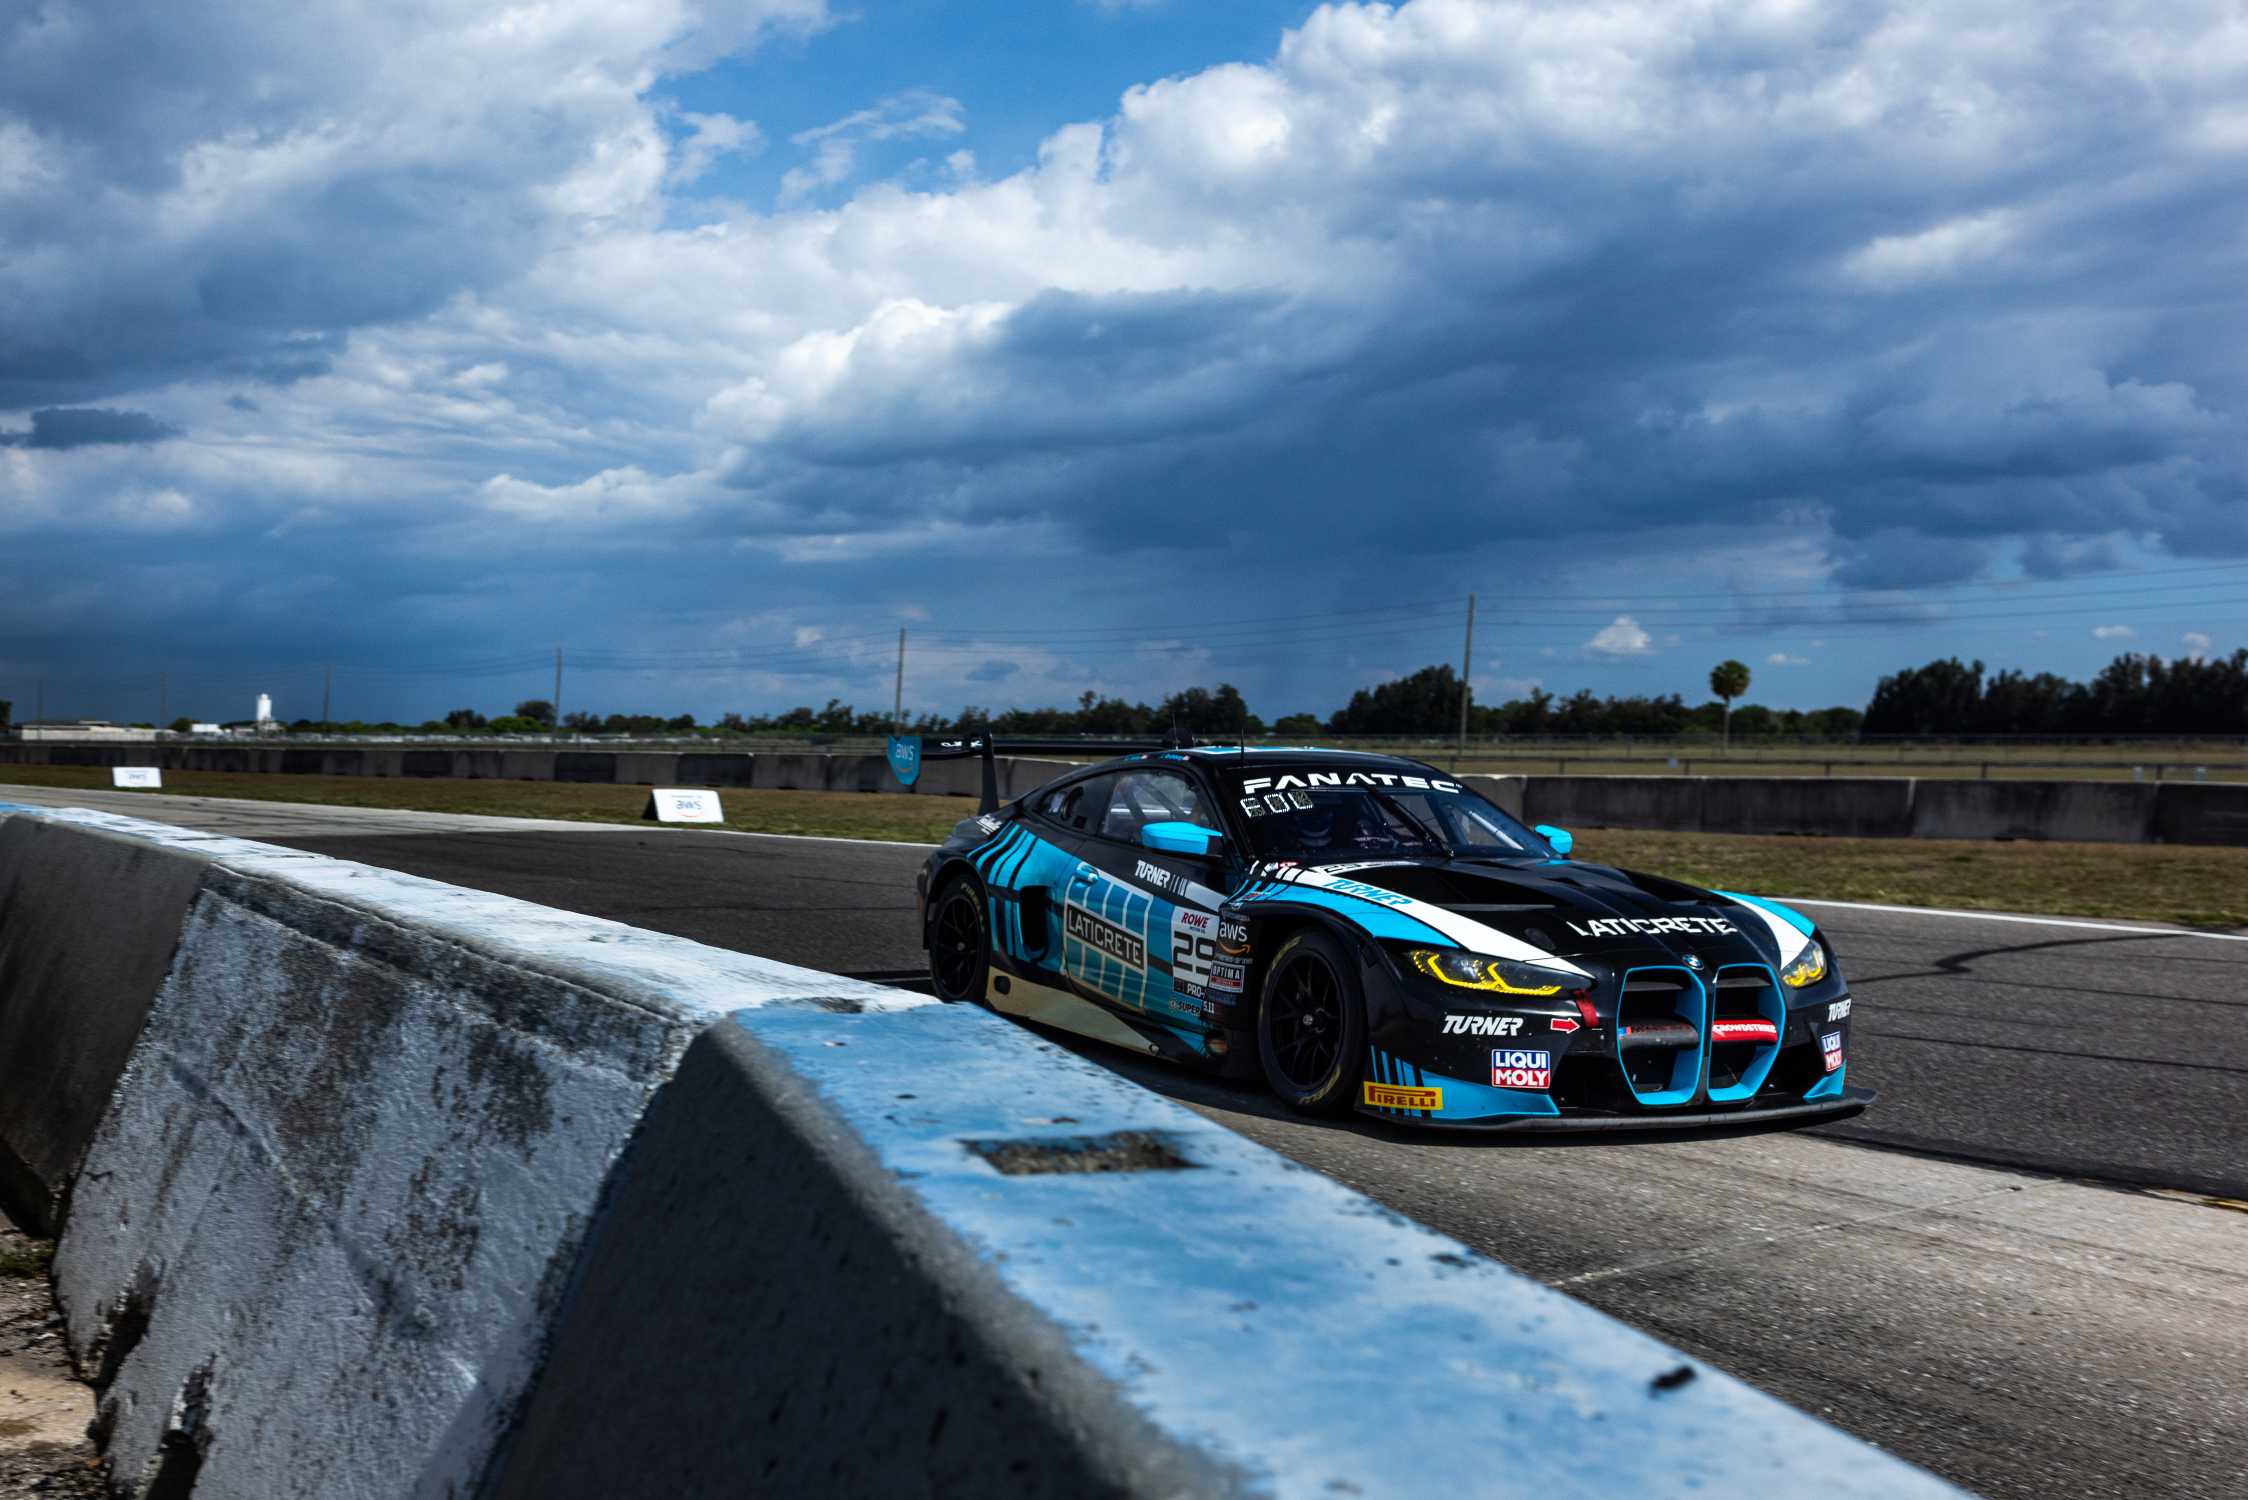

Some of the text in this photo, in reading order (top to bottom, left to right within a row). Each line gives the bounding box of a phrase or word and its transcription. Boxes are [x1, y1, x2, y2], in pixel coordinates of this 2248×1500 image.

[1243, 772, 1460, 794] FANATEC
[1135, 860, 1170, 889] TURNER
[1322, 879, 1413, 905] TURNER
[1181, 912, 1210, 928] ROWE
[1565, 917, 1738, 937] LATICRETE
[1069, 909, 1141, 964] LATICRETE
[1220, 921, 1247, 942] aws
[1173, 930, 1216, 976] 29
[1212, 965, 1240, 980] OPTIMA
[1828, 998, 1851, 1022] TURNER
[1442, 1015, 1524, 1036] TURNER
[1495, 1052, 1547, 1069] LIQUI
[1495, 1069, 1549, 1087] MOLY
[1368, 1085, 1437, 1107] PIRELLI
